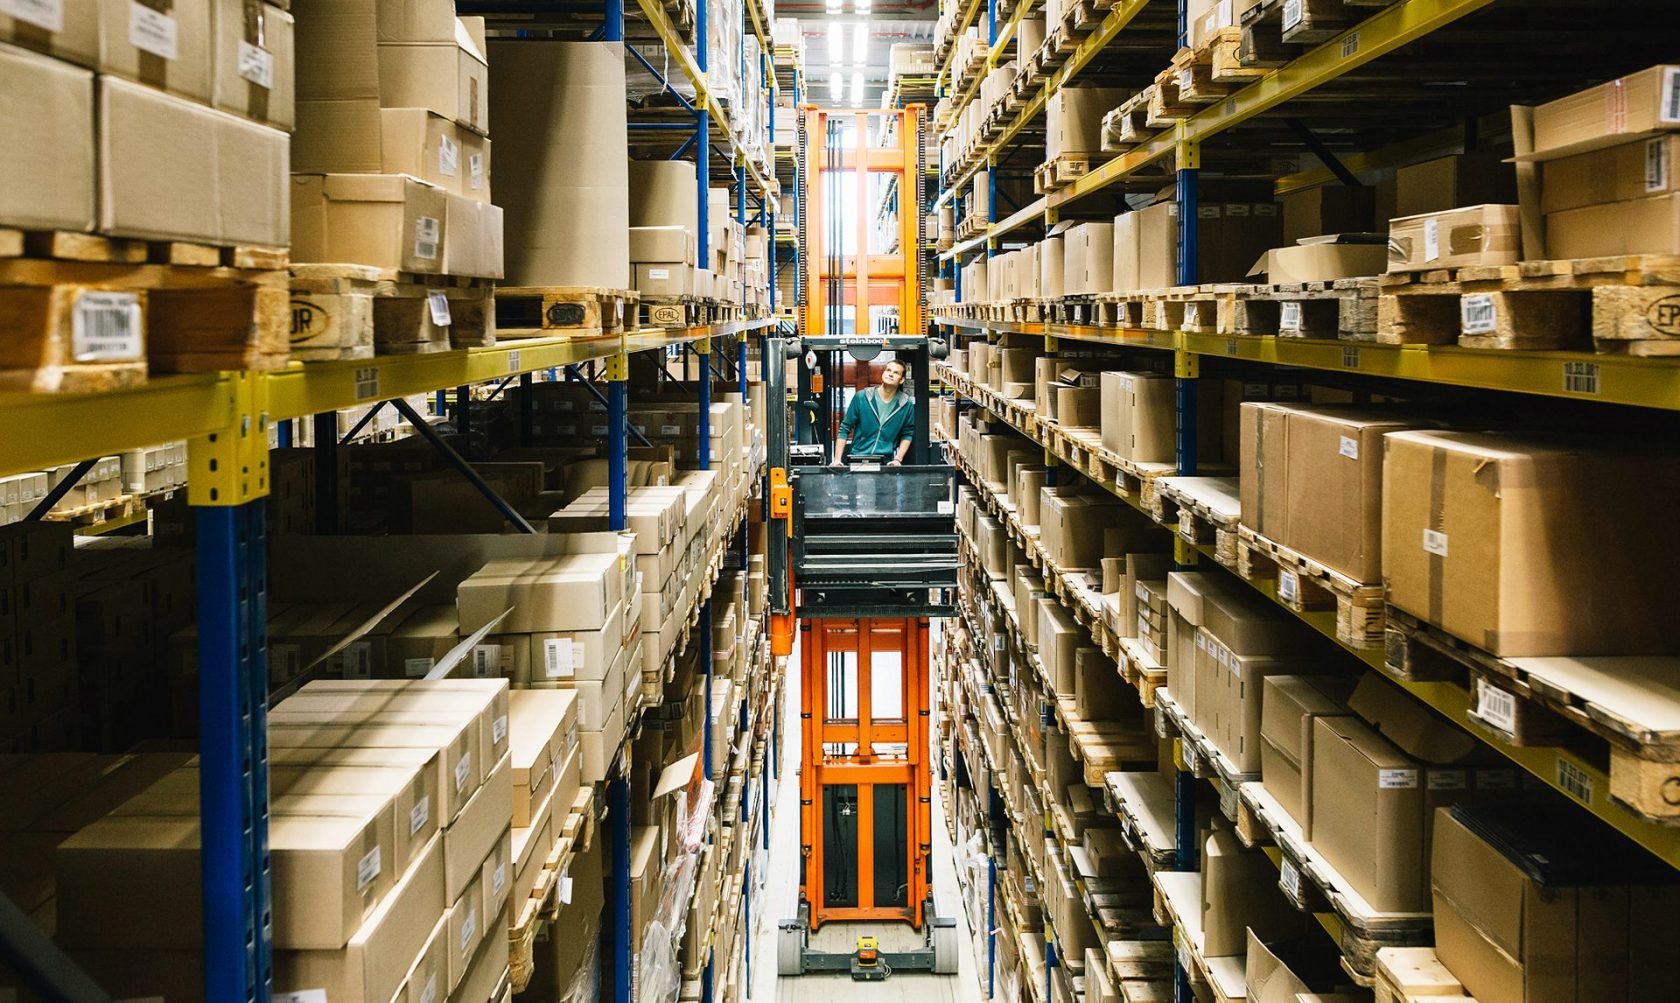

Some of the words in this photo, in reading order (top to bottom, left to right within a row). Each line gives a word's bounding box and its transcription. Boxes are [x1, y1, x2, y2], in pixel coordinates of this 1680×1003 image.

[290, 308, 312, 334] UR
[658, 307, 675, 319] EPAL
[1658, 304, 1680, 326] EP
